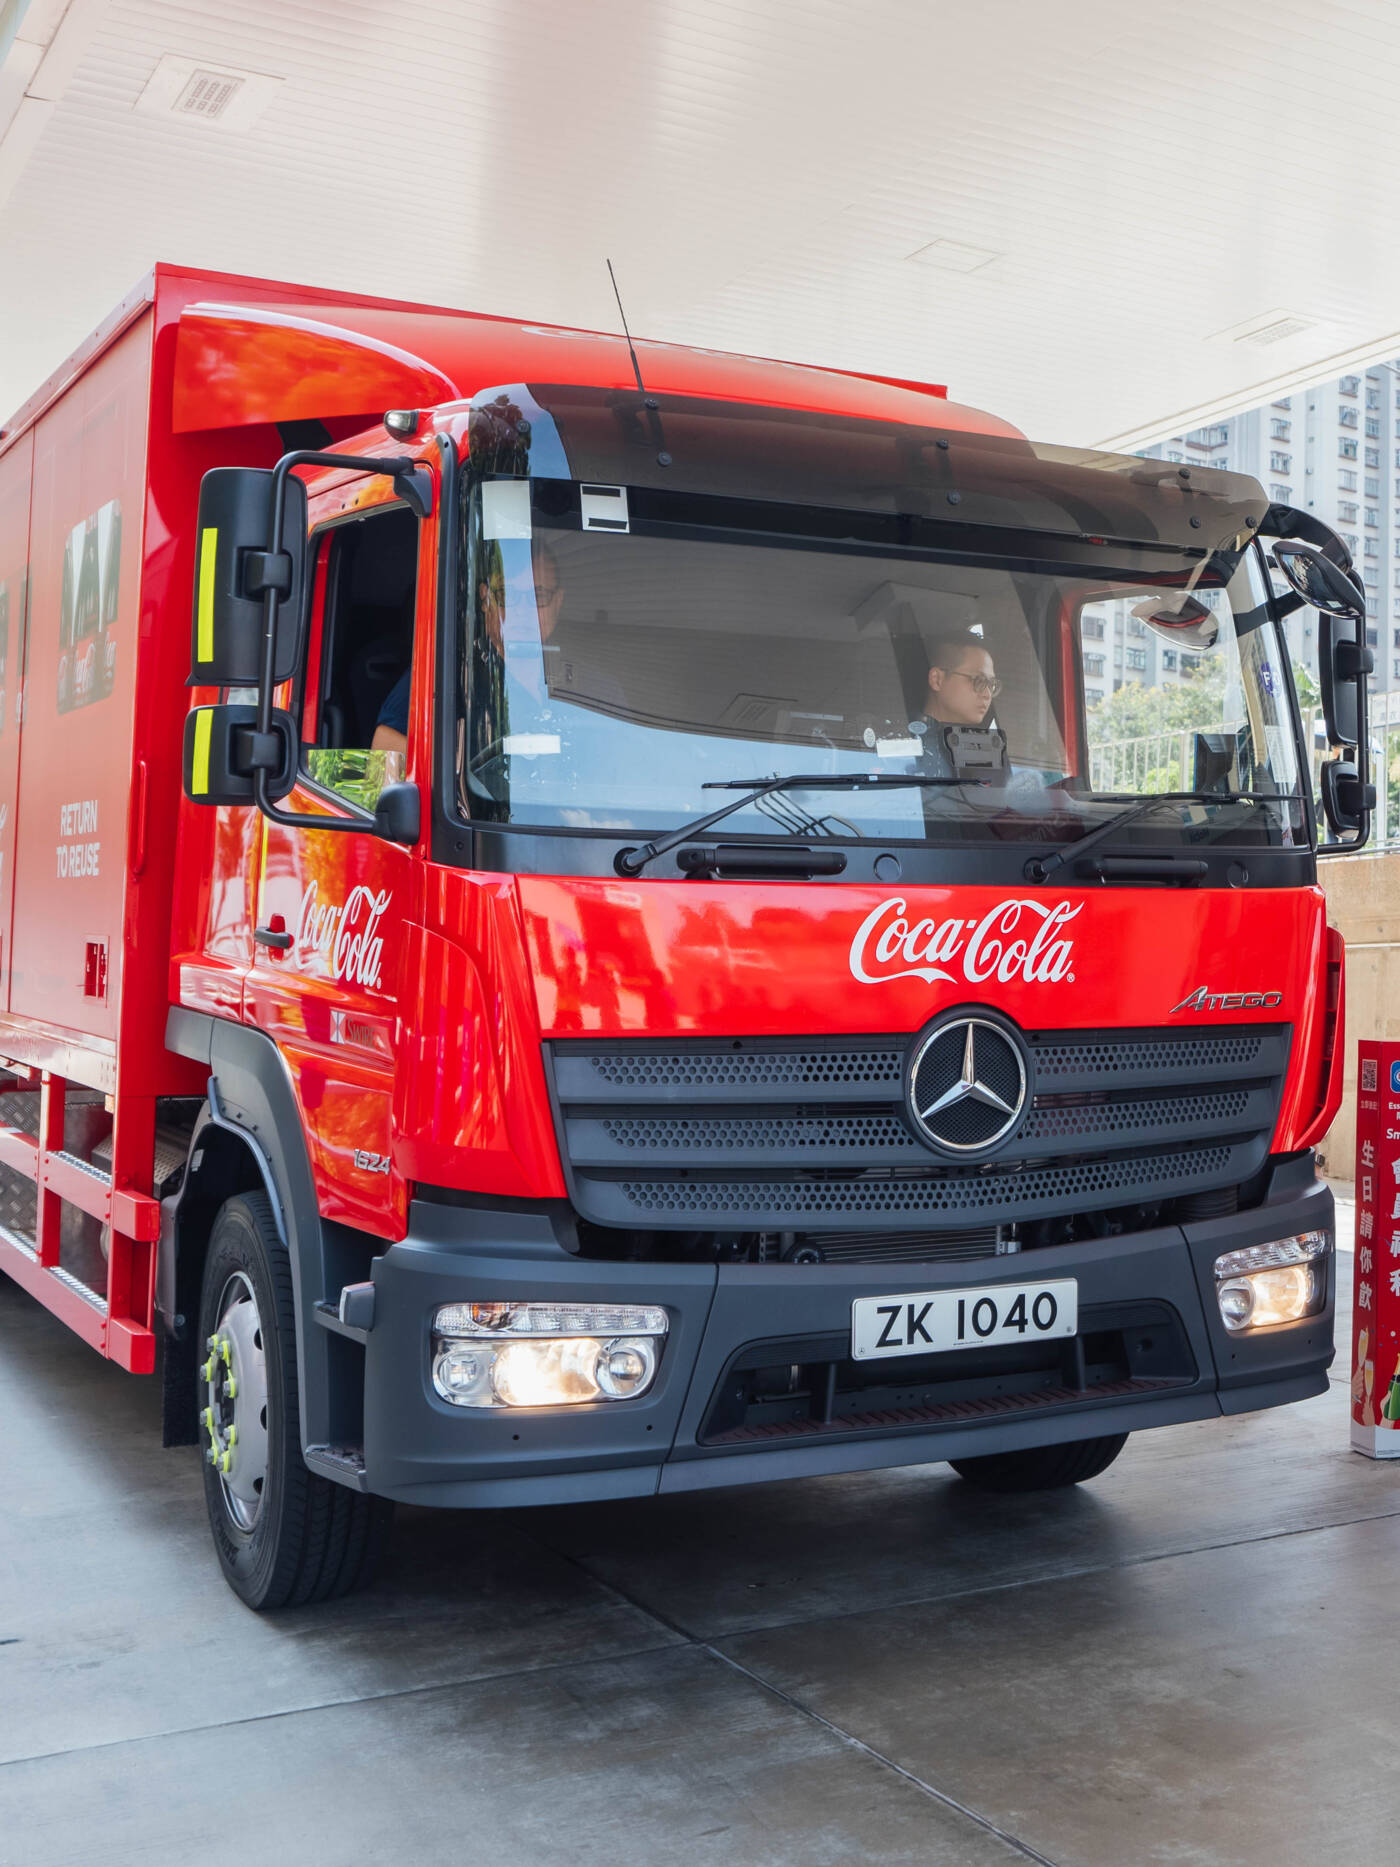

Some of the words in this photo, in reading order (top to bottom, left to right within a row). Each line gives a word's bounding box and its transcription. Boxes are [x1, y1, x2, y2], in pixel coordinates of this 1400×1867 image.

[61, 800, 98, 837] RETURN
[56, 845, 68, 878] TO
[69, 842, 100, 878] REUSE
[295, 880, 393, 989] Coca-Cola
[849, 897, 1084, 985] Coca-Cola
[1170, 986, 1282, 1014] ATEGO
[354, 1149, 391, 1175] 1624
[1358, 1139, 1375, 1311] 生日請你飲
[875, 1302, 933, 1348] ZK
[957, 1291, 1058, 1341] 1040
